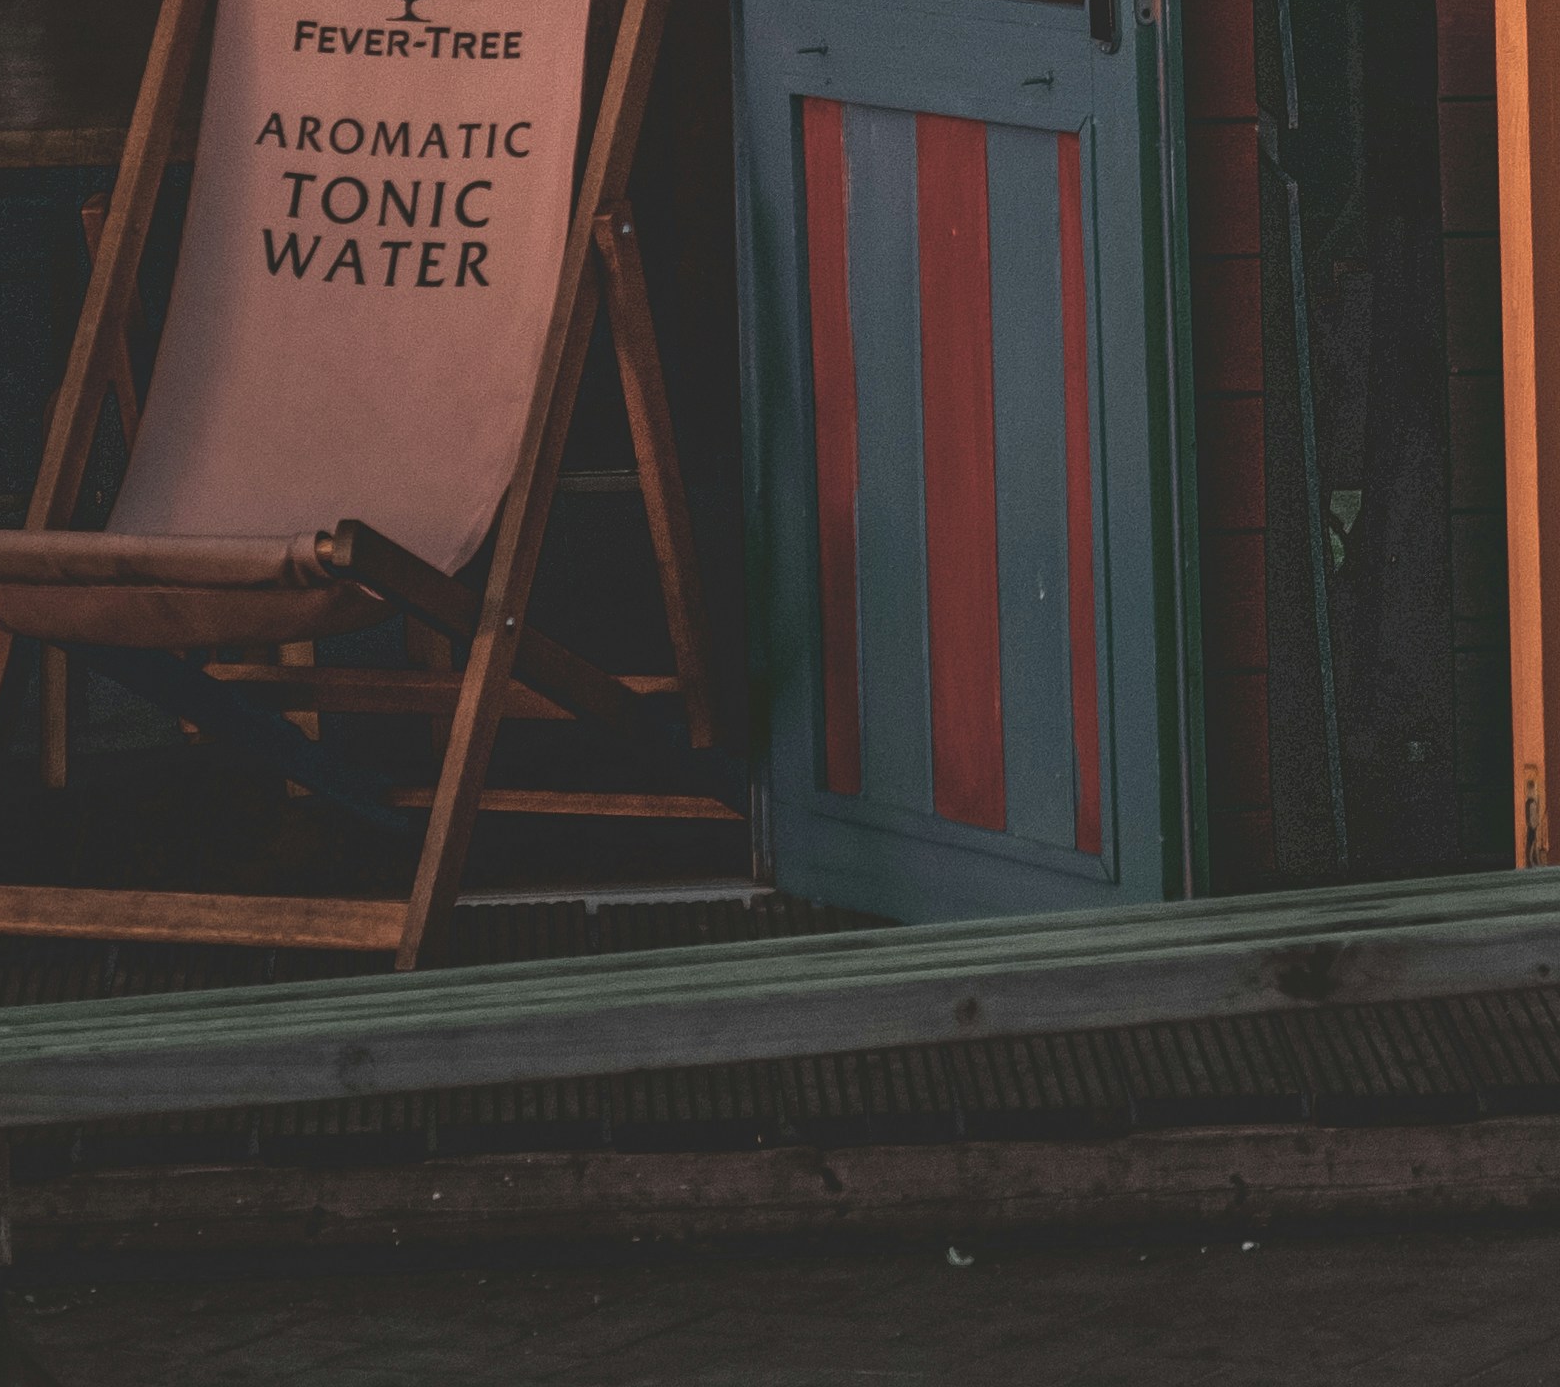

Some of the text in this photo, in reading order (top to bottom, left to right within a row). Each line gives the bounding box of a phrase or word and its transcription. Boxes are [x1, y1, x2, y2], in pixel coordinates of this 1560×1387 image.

[293, 20, 523, 60] FEVER-TREE
[255, 112, 532, 158] AROMATIC
[282, 171, 493, 229] TONIC
[262, 229, 490, 287] WATER
